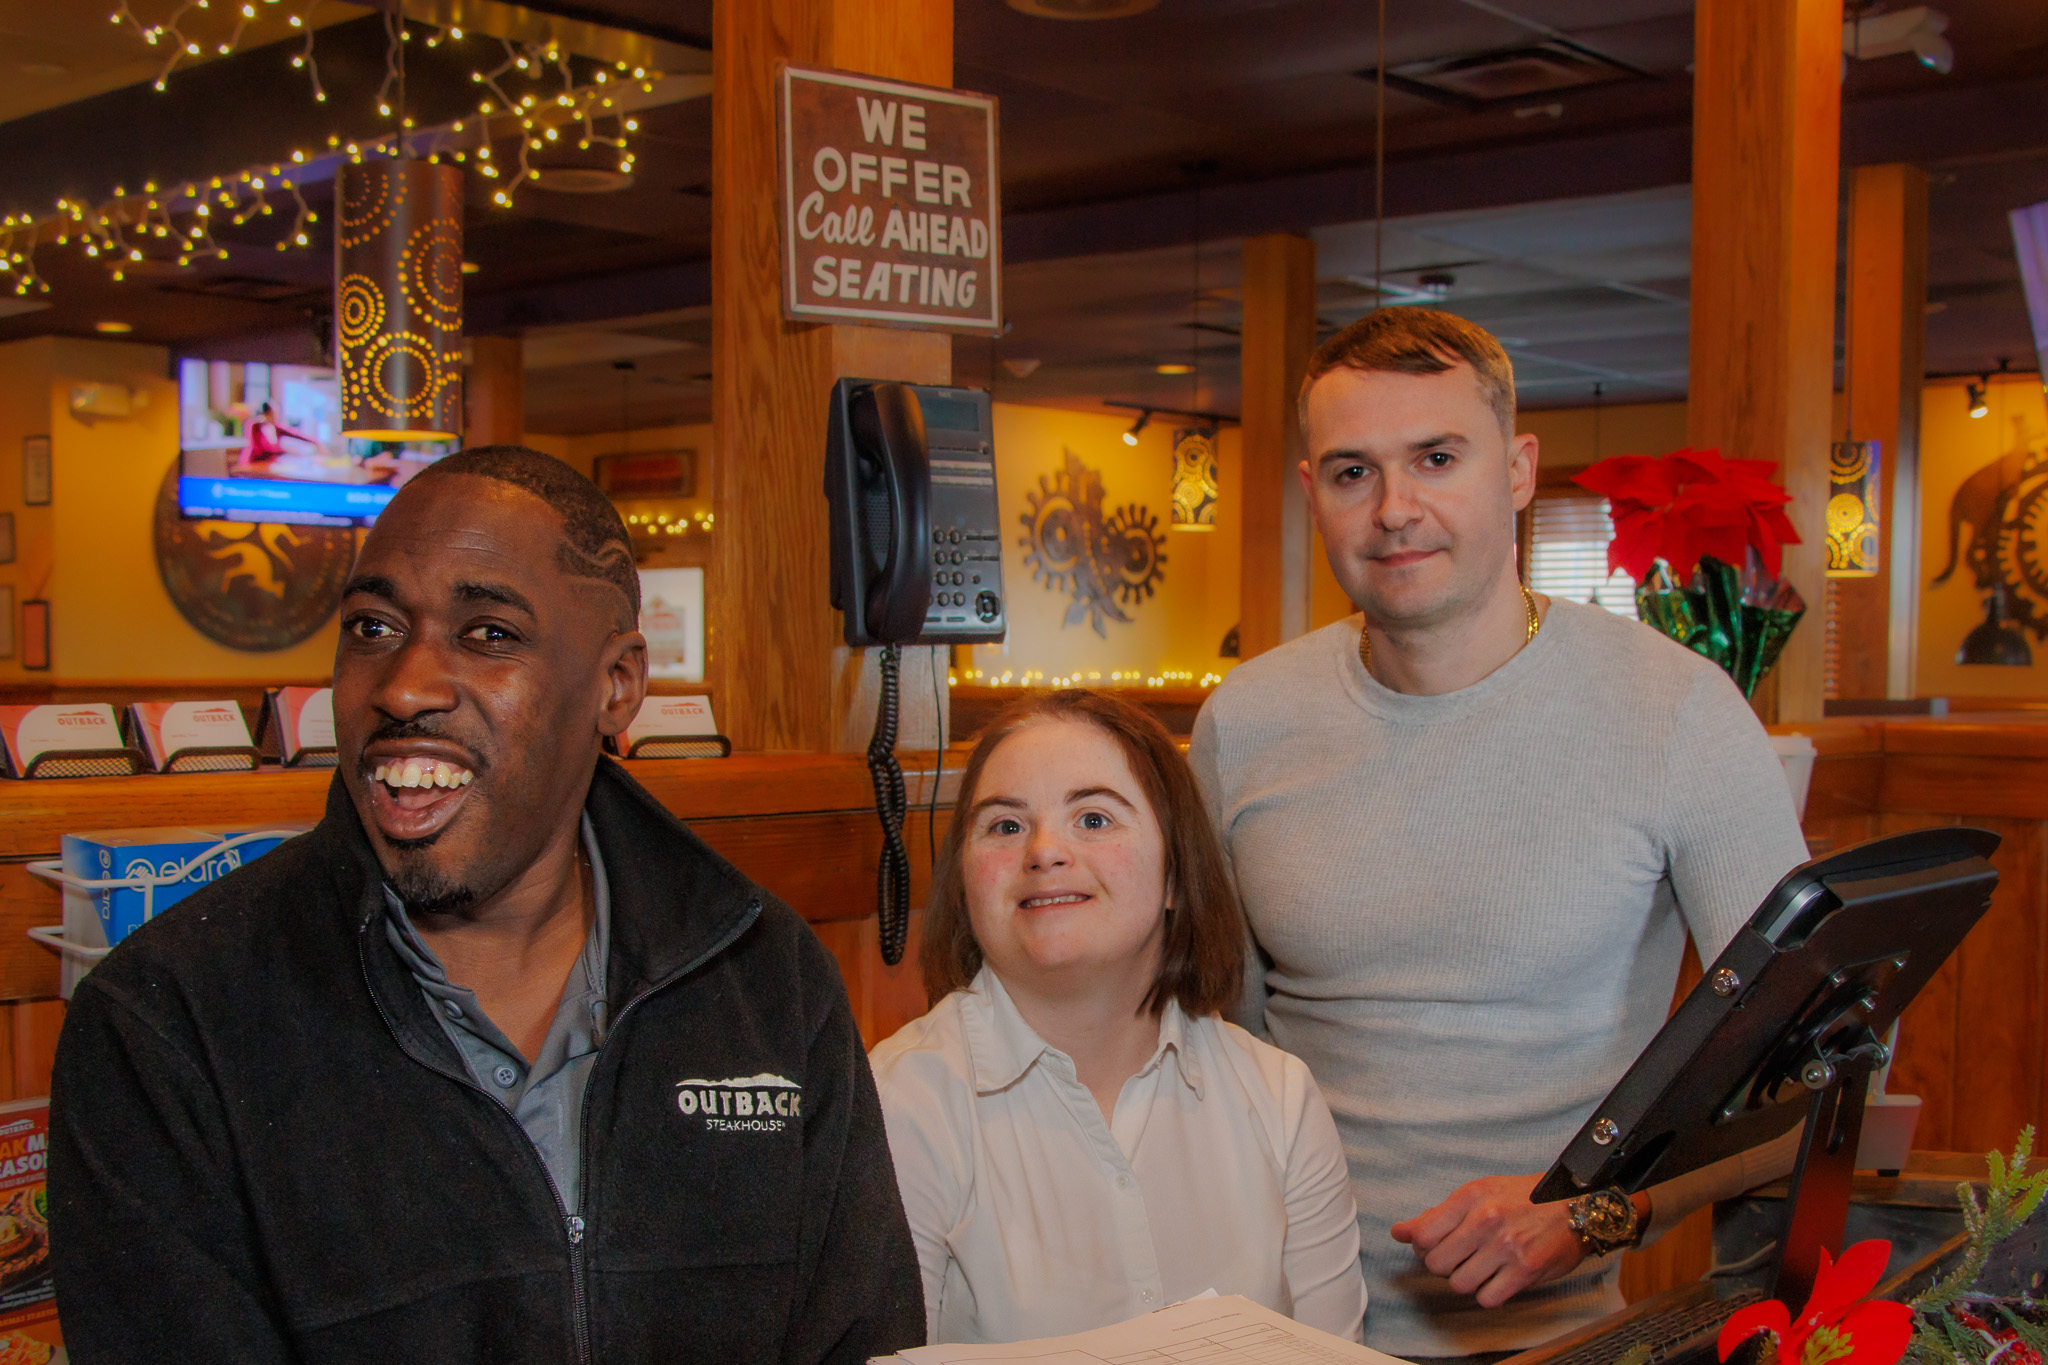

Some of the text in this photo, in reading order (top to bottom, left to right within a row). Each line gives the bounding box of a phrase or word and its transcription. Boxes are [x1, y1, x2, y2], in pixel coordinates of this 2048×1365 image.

[857, 96, 926, 150] WE
[813, 146, 972, 208] OFFER
[797, 190, 988, 259] Call AHEAD
[812, 255, 977, 308] SEATING
[57, 717, 107, 726] OUTBACK
[193, 714, 236, 722] OUTBACK
[661, 707, 704, 715] OUTBACK
[678, 1090, 801, 1116] OUTBACK
[0, 1133, 48, 1160] AKM
